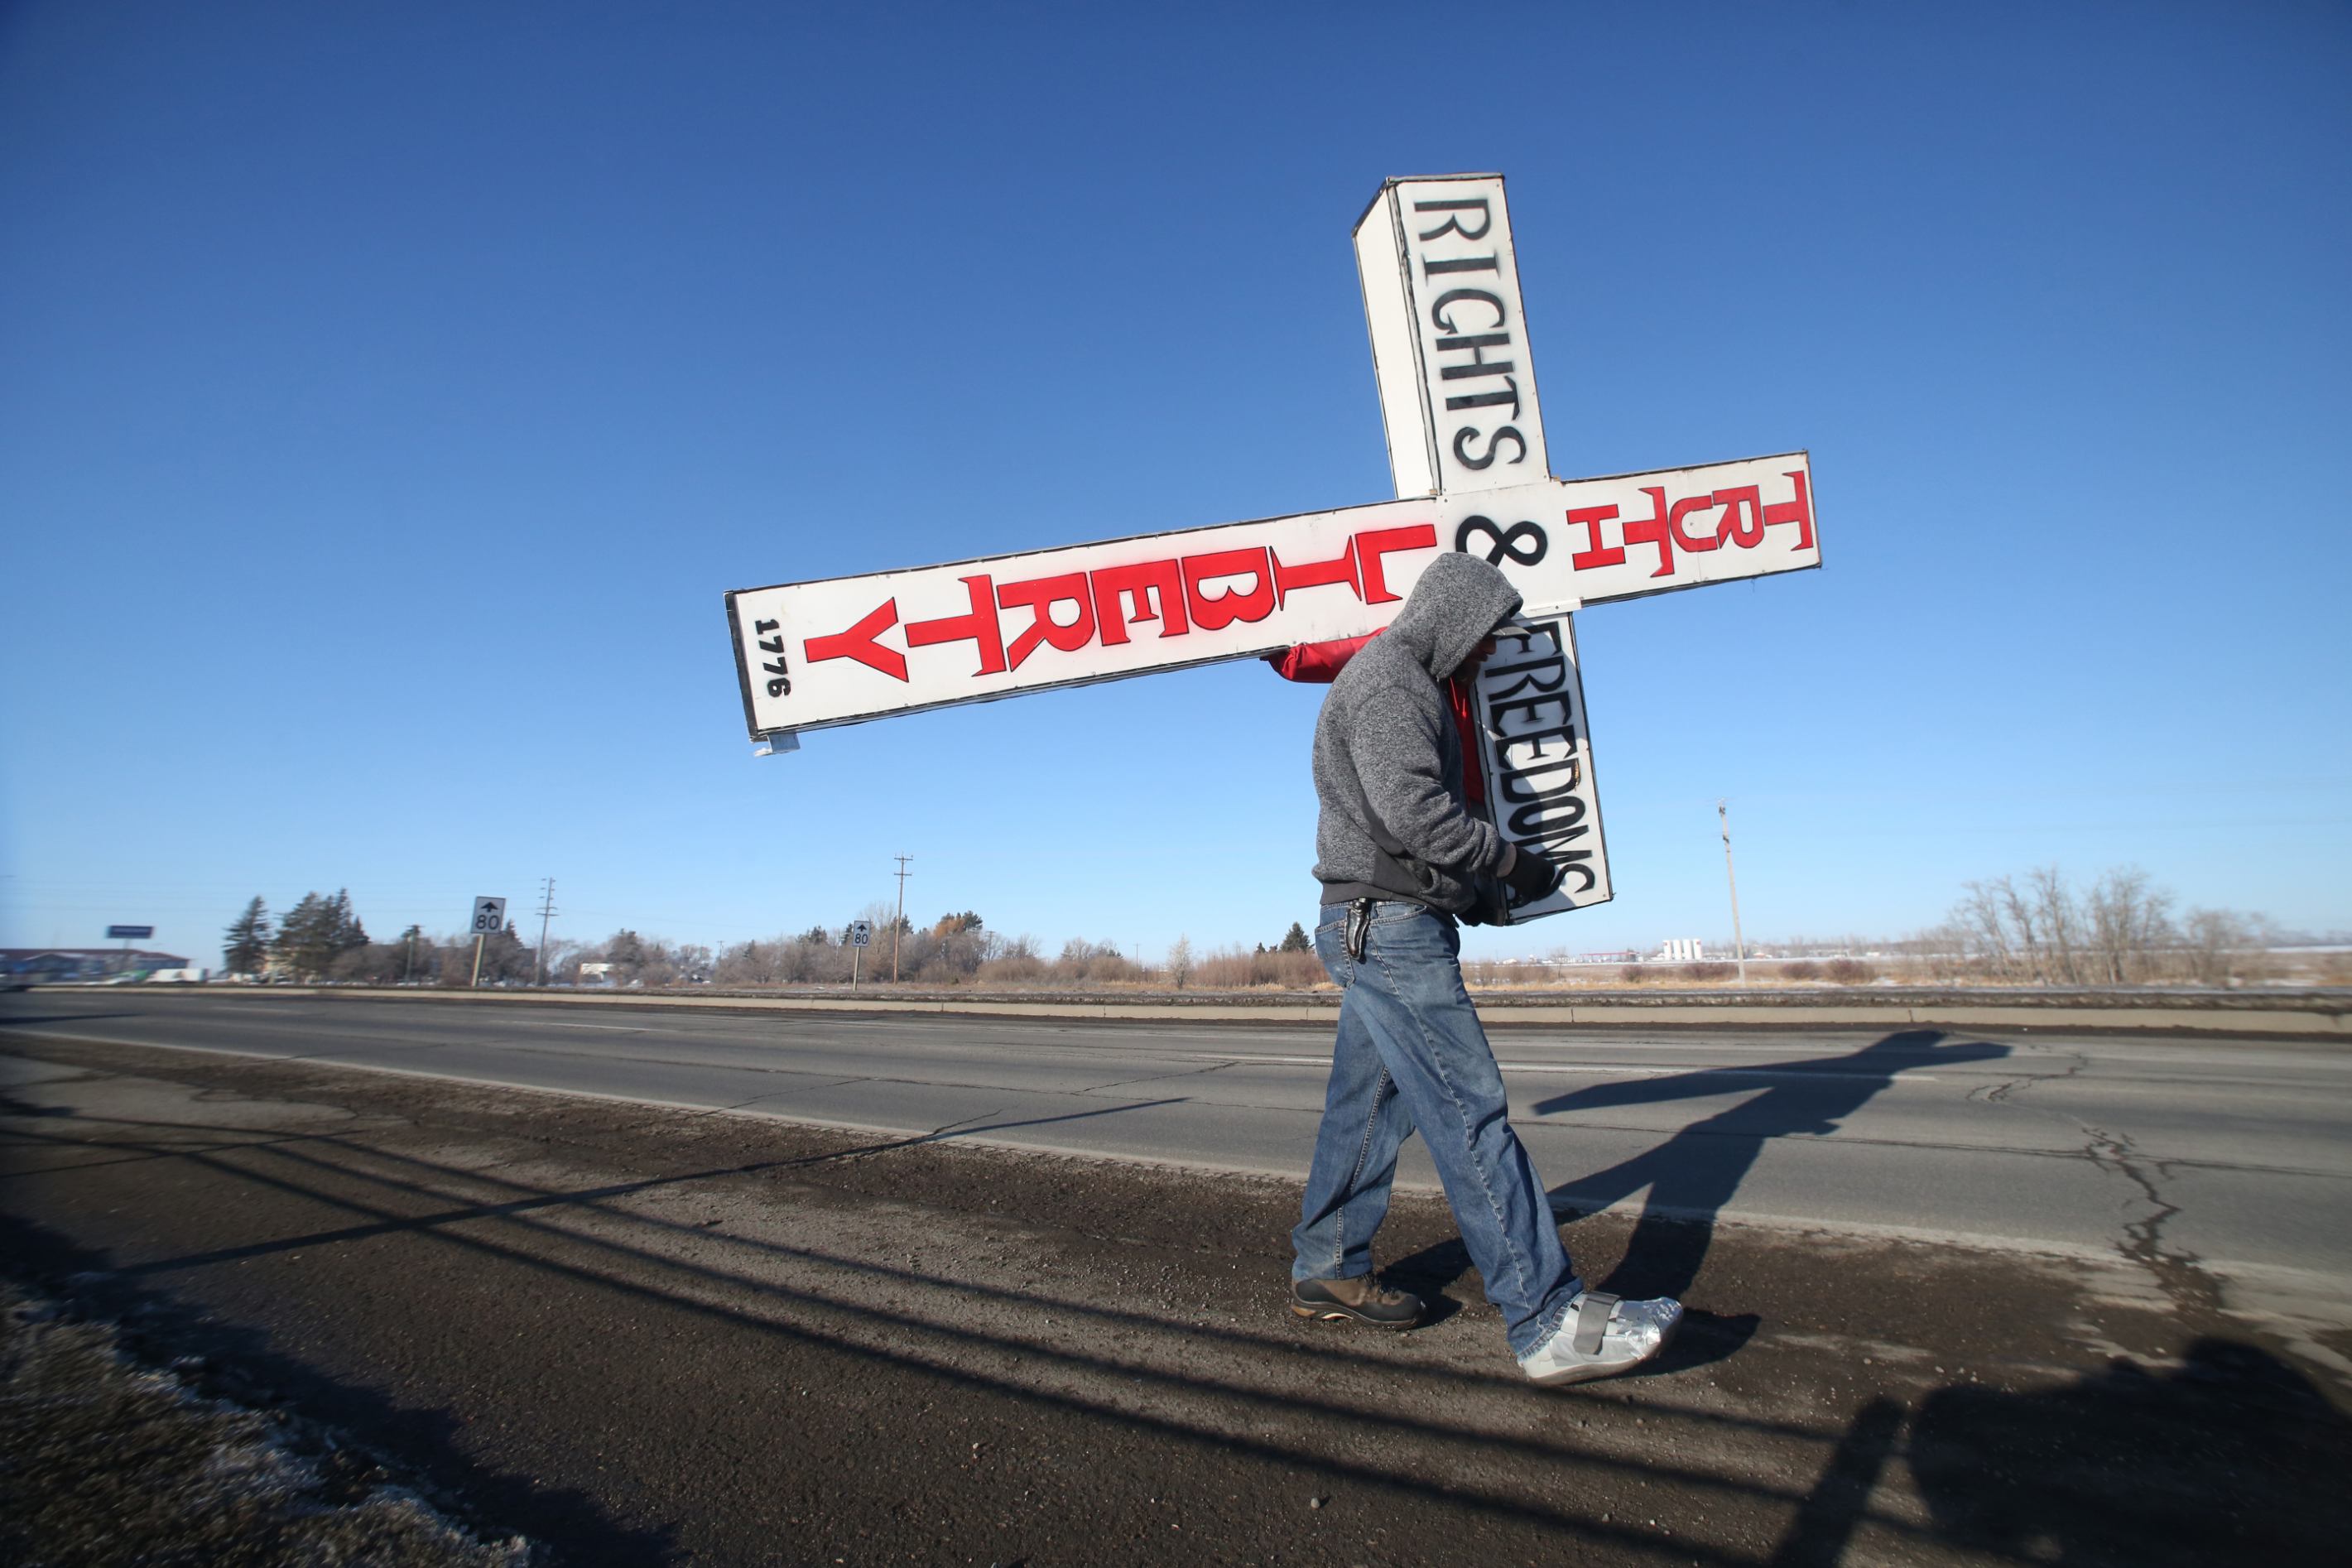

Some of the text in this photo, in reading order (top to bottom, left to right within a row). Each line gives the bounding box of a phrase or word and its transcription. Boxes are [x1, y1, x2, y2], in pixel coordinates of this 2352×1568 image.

[1414, 199, 1595, 910] RIGHTS & FREEDOMS
[1566, 470, 1814, 578] TRUTH
[803, 523, 1438, 683] LIBERTY
[754, 618, 791, 699] 1776
[475, 914, 500, 931] 80
[854, 933, 868, 945] 80
